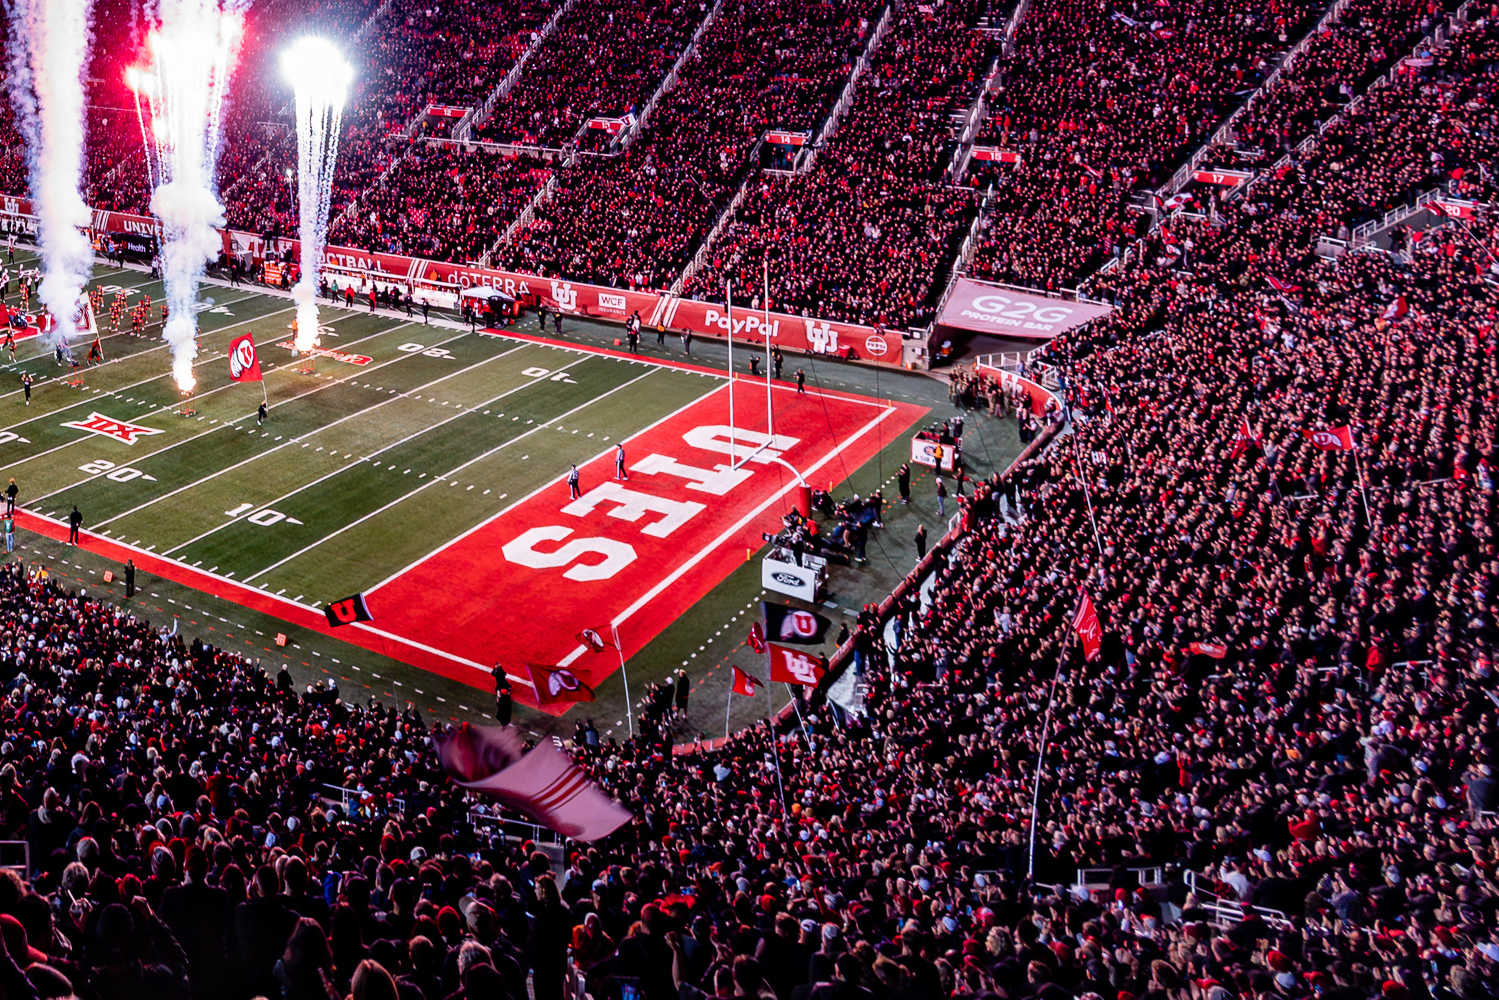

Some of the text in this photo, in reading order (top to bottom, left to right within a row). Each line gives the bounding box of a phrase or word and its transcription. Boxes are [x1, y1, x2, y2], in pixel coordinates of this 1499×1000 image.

[990, 152, 1002, 160] 15
[1212, 174, 1225, 184] 17
[1445, 204, 1460, 216] 20
[127, 242, 146, 253] Health
[601, 296, 624, 308] WCF
[972, 295, 1073, 323] G2G
[704, 310, 779, 338] PayPal
[961, 309, 1053, 331] PROTEIN BAR
[78, 459, 144, 483] 20
[501, 424, 801, 582] UTES
[224, 503, 287, 527] 10
[777, 575, 801, 587] Ford
[330, 598, 358, 623] U
